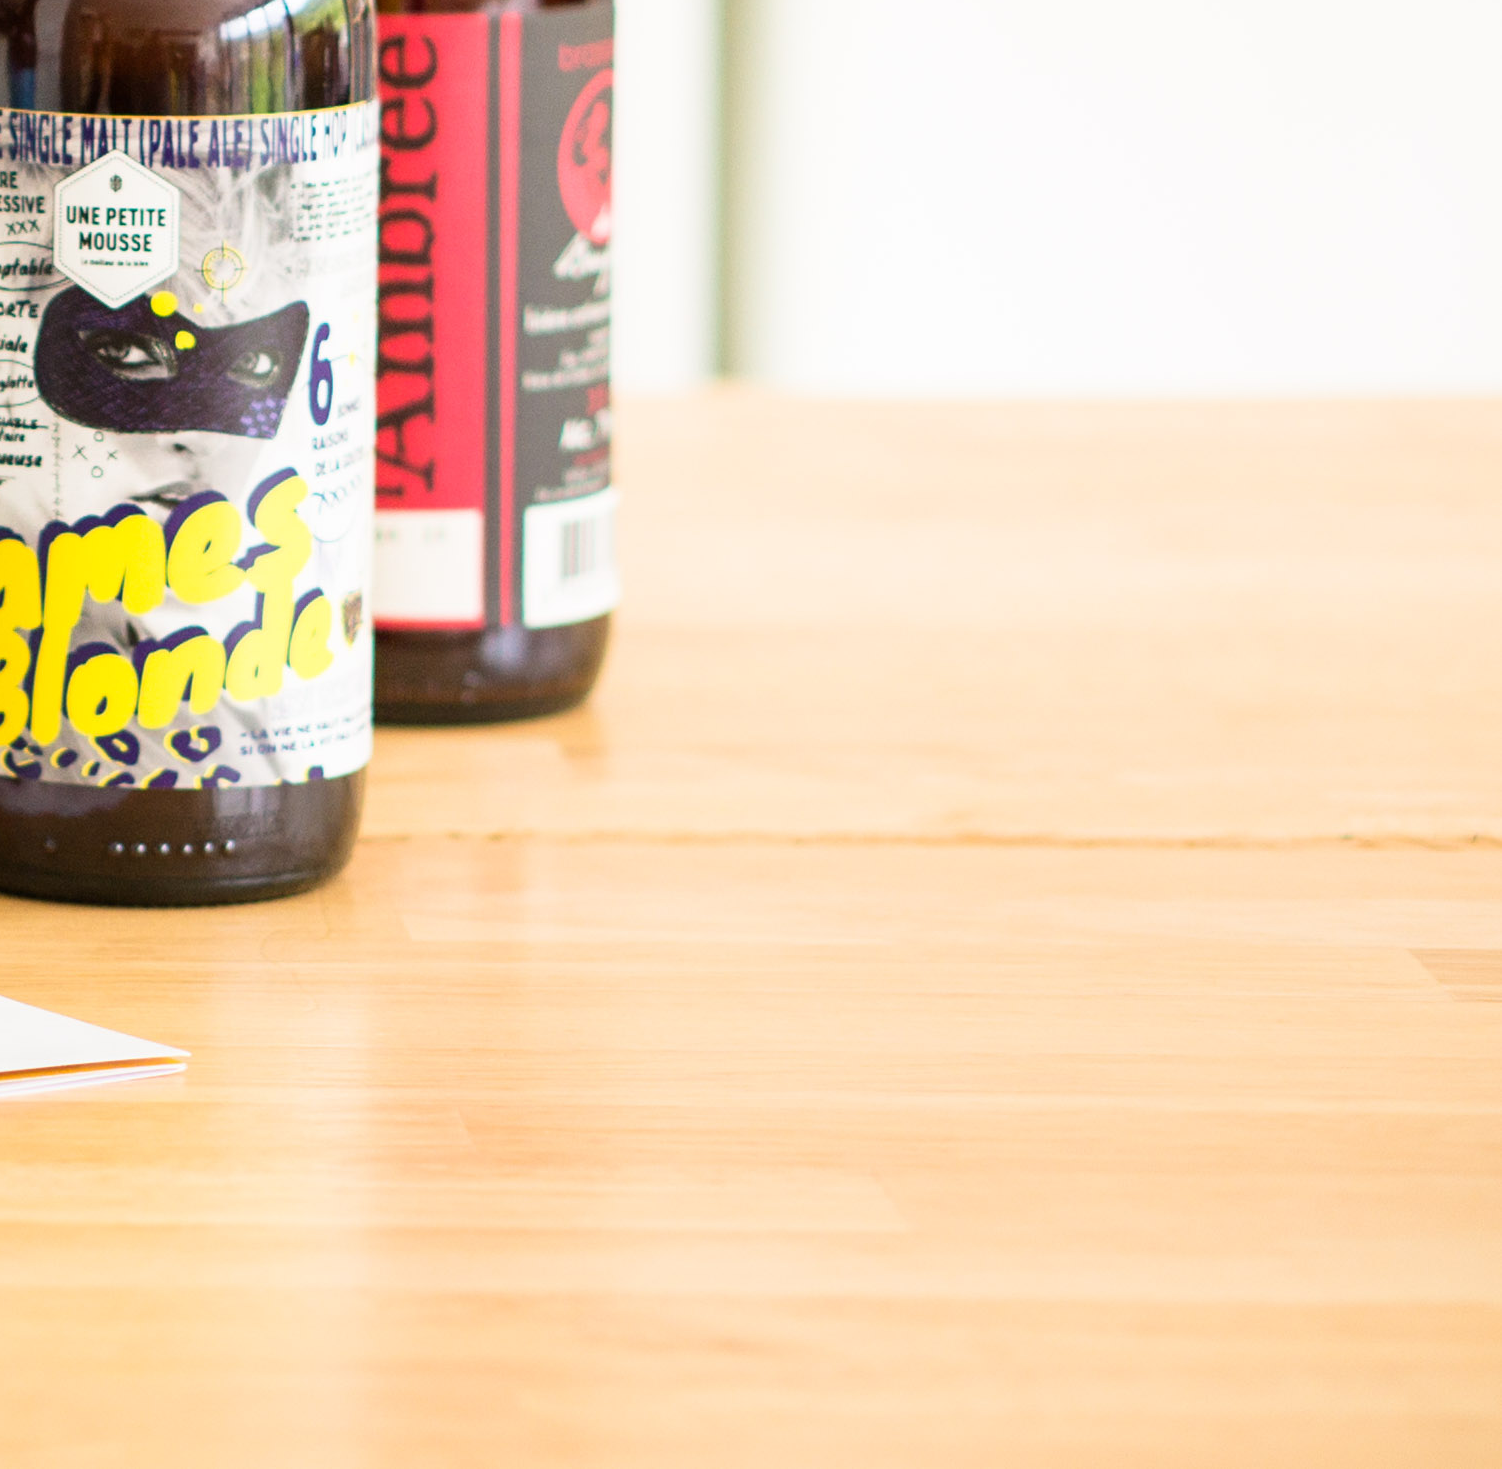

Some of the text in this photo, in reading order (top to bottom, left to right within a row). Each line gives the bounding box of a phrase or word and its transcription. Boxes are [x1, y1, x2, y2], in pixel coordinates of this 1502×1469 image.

[8, 111, 73, 165] SINGLE
[80, 116, 133, 166] MALT
[138, 118, 201, 169] (PALE
[207, 117, 253, 172] ALE)
[259, 113, 318, 167] SINGLE
[66, 205, 167, 228] UNE PETITE
[78, 230, 153, 253] MOUSSE
[308, 321, 334, 426] 6
